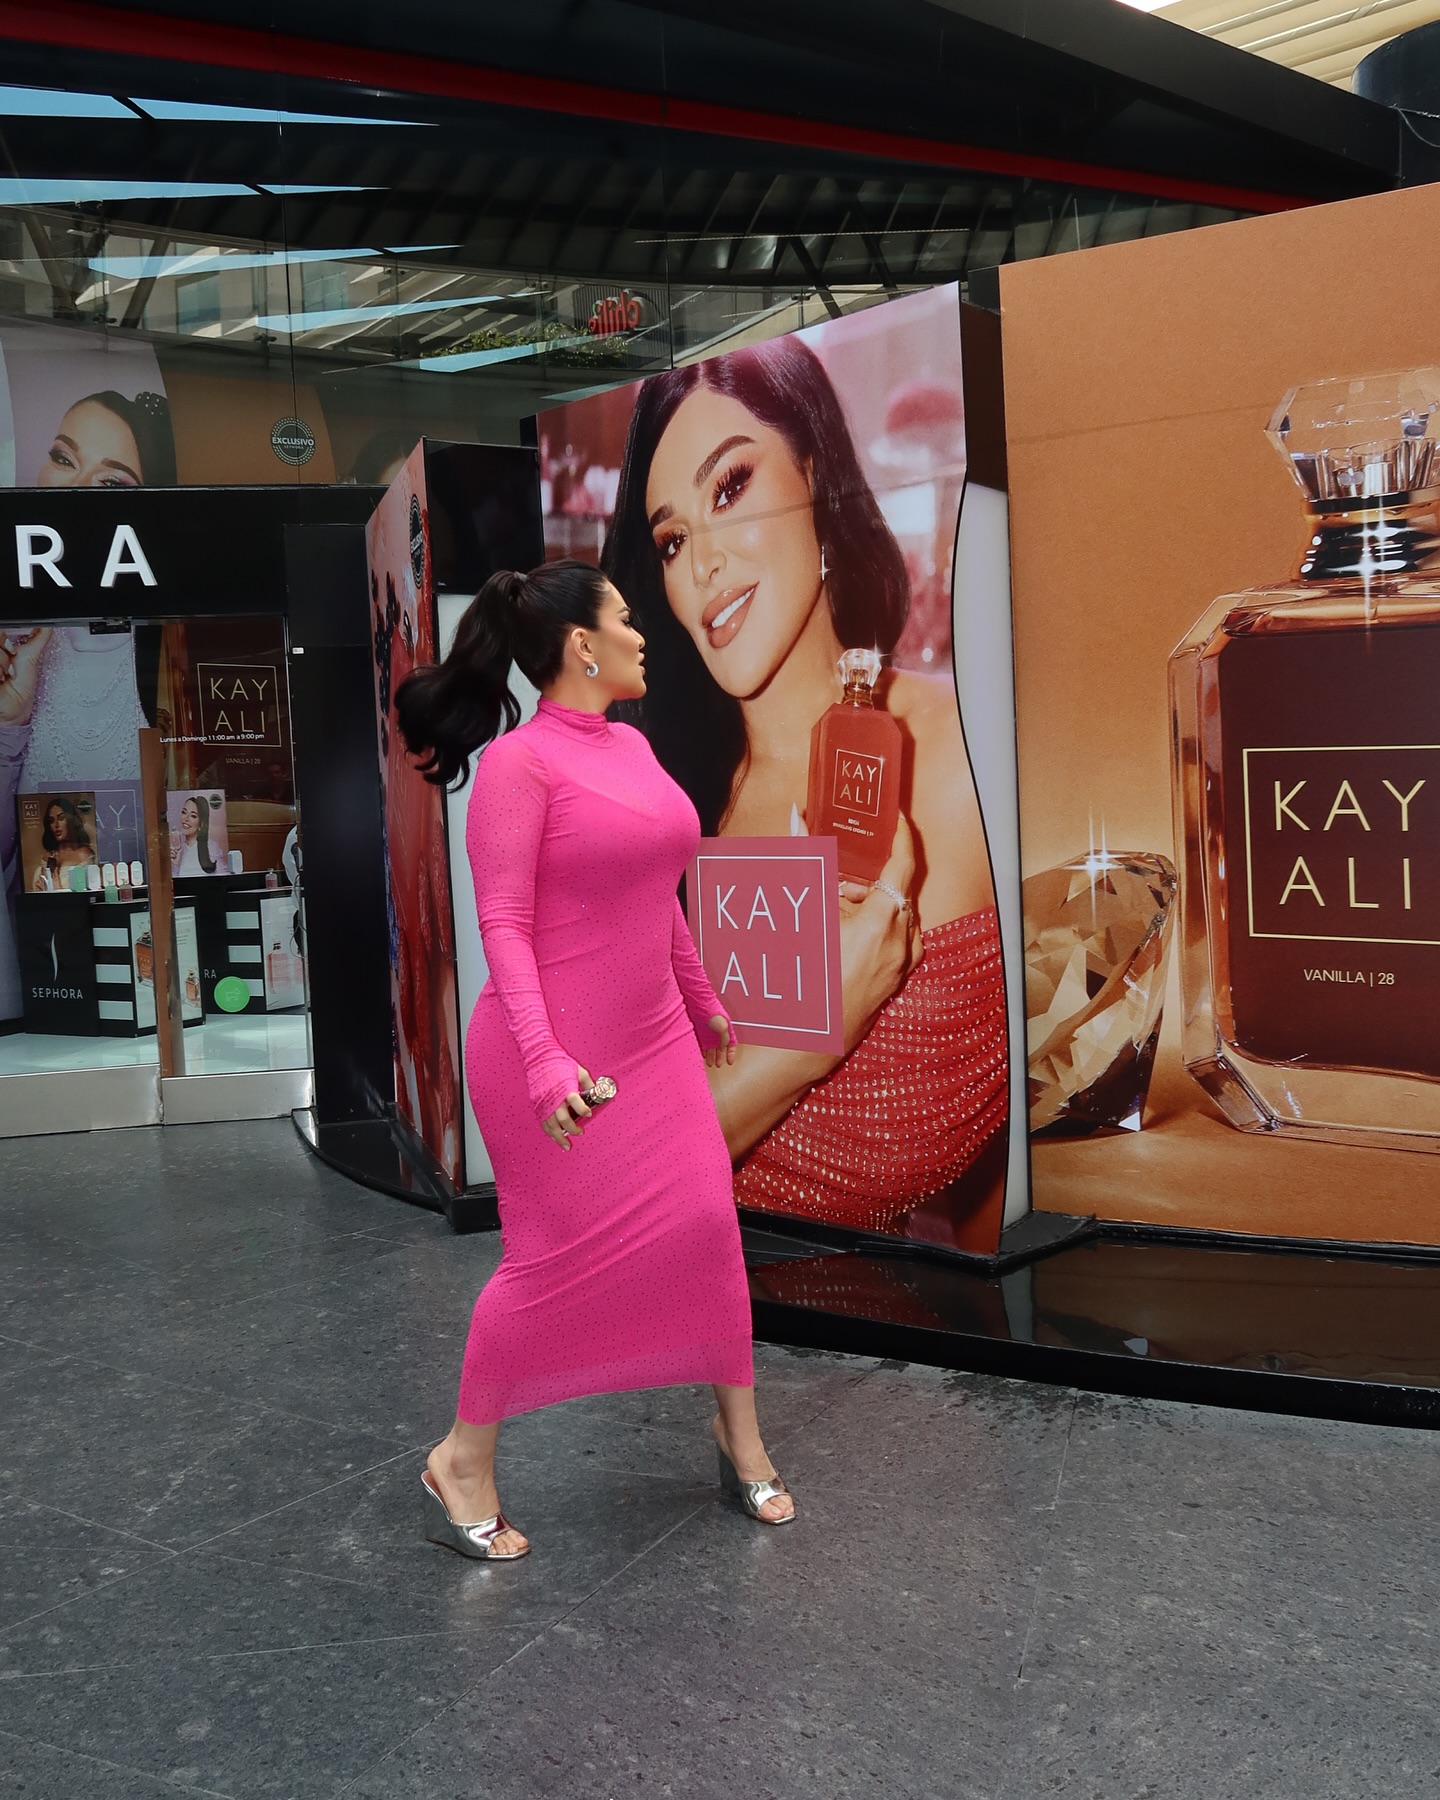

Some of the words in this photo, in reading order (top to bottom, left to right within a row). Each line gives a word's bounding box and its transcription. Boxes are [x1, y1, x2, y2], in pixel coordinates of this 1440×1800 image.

[272, 437, 315, 446] EXCLUSIVO
[211, 677, 269, 701] KAY
[214, 710, 266, 733] ALI
[841, 759, 878, 783] KAY
[840, 783, 872, 806] ALI
[1274, 779, 1427, 832] KAY
[1279, 856, 1412, 910] ALI
[716, 884, 811, 933] KAY
[720, 951, 803, 1002] ALI
[1303, 969, 1366, 984] VANILLA
[1377, 972, 1395, 985] 28
[32, 987, 84, 1000] SEPHORA
